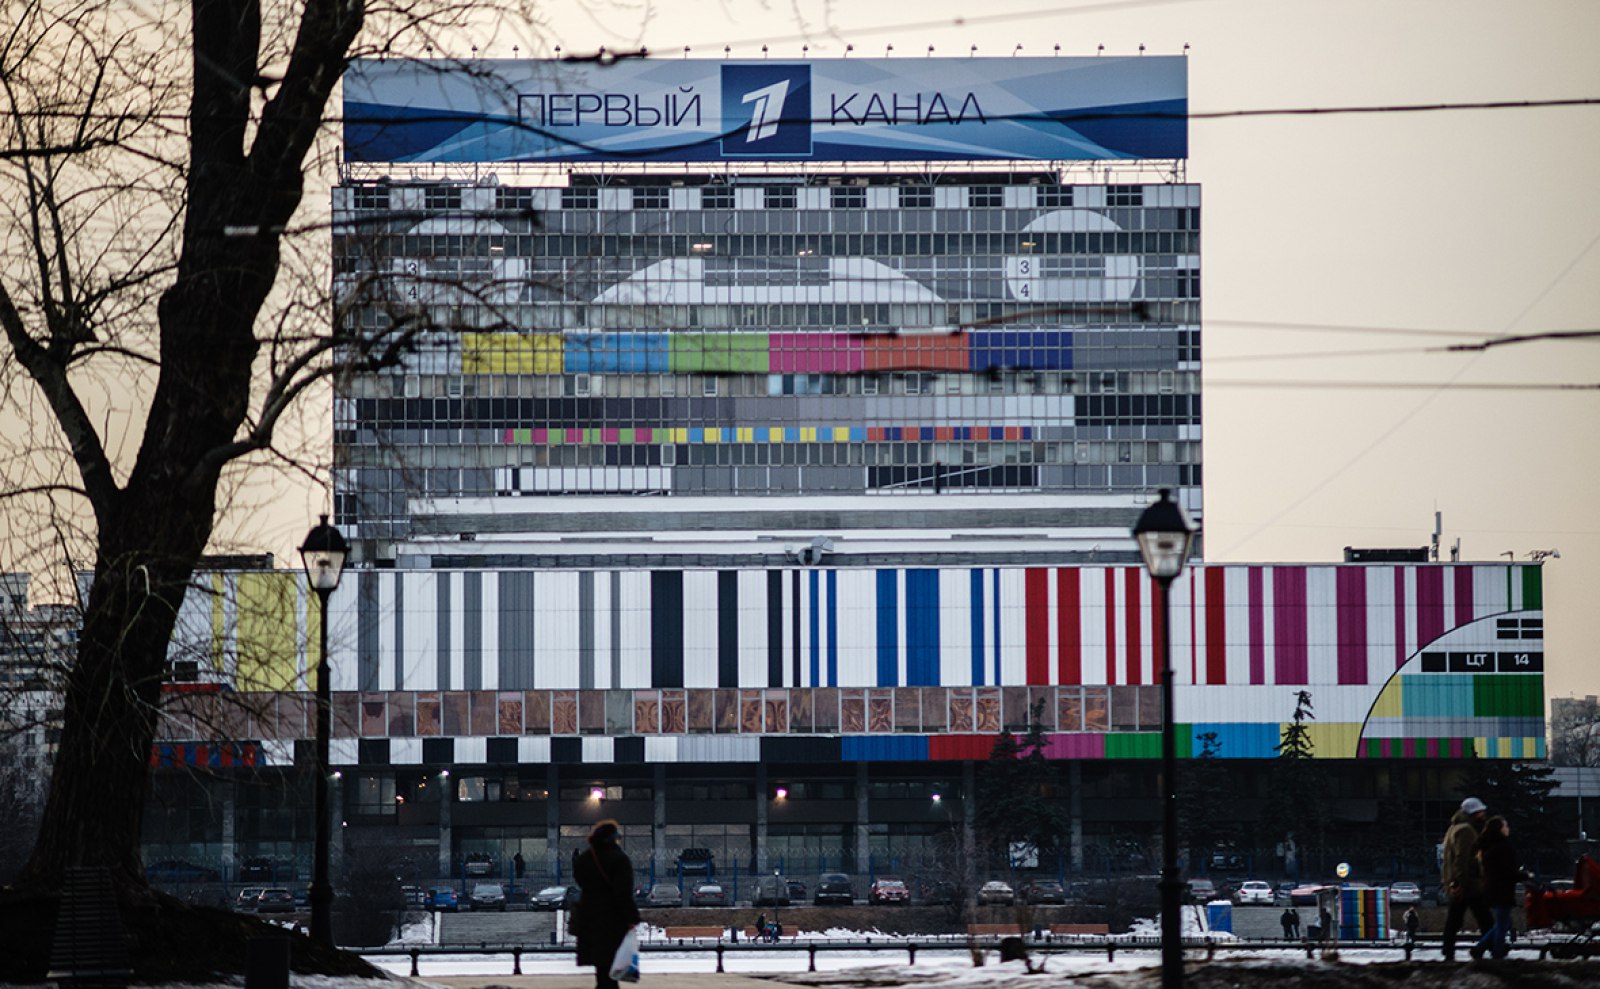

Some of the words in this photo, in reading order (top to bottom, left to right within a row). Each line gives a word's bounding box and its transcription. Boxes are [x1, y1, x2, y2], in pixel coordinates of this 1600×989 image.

[517, 87, 702, 127] ПЕРВЫЙ
[831, 92, 987, 126] КАНАЛ
[408, 263, 417, 276] 3
[1020, 260, 1030, 274] 3
[408, 286, 417, 298] 4
[1020, 283, 1030, 297] 4
[1466, 654, 1487, 667] ЦТ
[1513, 654, 1529, 665] 14
